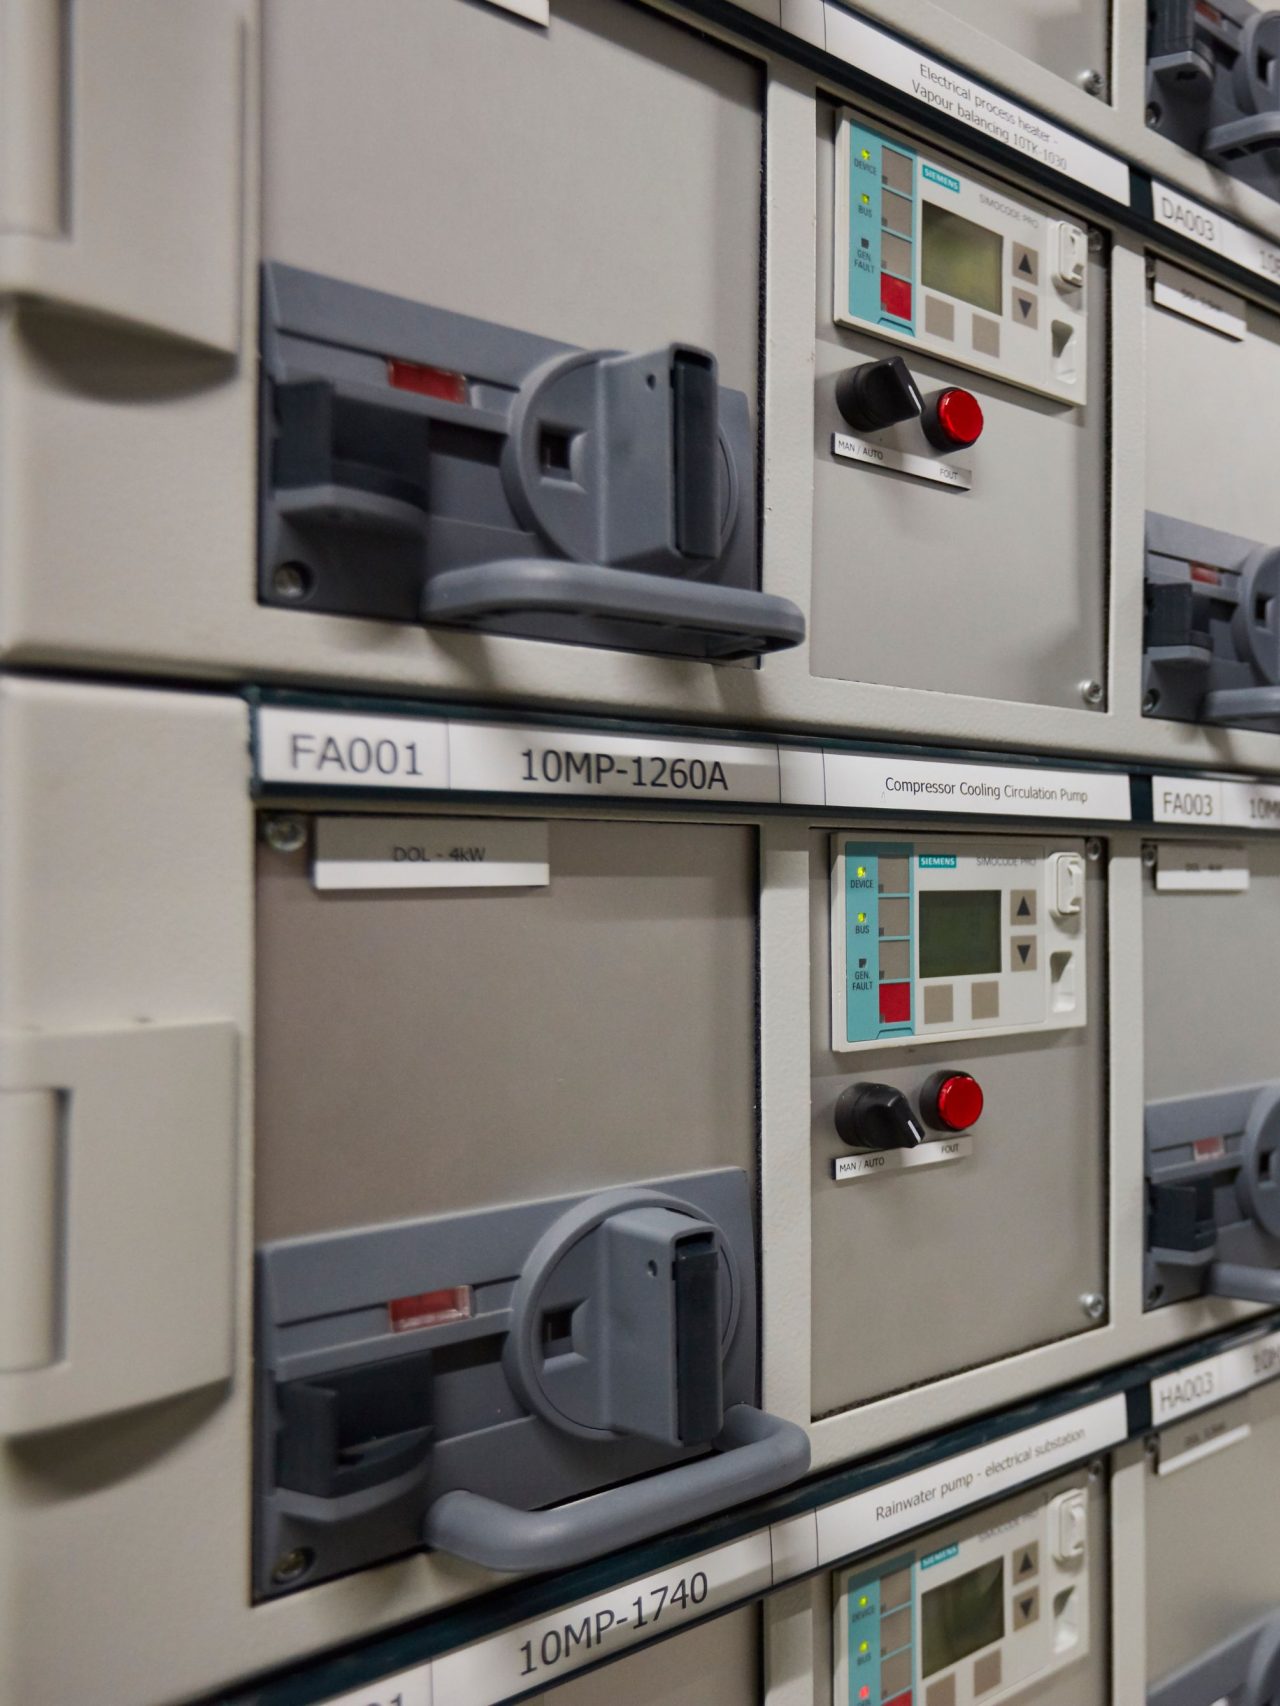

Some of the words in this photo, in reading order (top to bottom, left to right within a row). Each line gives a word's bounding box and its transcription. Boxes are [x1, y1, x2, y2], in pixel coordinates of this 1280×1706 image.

[911, 79, 955, 111] Vapour
[957, 102, 1010, 144] balancing
[919, 63, 971, 100] Electrical
[974, 95, 1016, 125] process
[1017, 115, 1050, 144] heater
[854, 158, 877, 176] DEVICE
[924, 168, 959, 190] SIEMENS
[857, 205, 873, 218] BUS
[1162, 196, 1214, 241] DA003
[854, 259, 876, 274] FAULT
[838, 440, 855, 452] MAN
[862, 447, 884, 460] AUTO
[939, 468, 959, 480] FOUT
[289, 733, 423, 776] FA001
[521, 748, 730, 791] 10MP-1260A
[885, 776, 956, 795] Compressor
[959, 781, 1001, 800] Cooling
[1004, 784, 1057, 800] Circulation
[1060, 789, 1089, 804] Pump
[1163, 791, 1214, 817] FA003
[392, 846, 431, 862] DOL
[449, 847, 486, 862] 4kW
[920, 857, 956, 866] SIEMENS
[850, 879, 874, 889] DEVICE
[855, 925, 870, 934] BUS
[852, 981, 873, 991] FAULT
[839, 1162, 857, 1172] MAN
[864, 1157, 885, 1168] AUTO
[1159, 1371, 1214, 1411] HA003
[875, 1487, 936, 1521] Rainwater
[940, 1472, 974, 1499] pump
[984, 1447, 1033, 1477] electrical
[1034, 1427, 1086, 1456] substation
[520, 1571, 709, 1676] 10MP-1740
